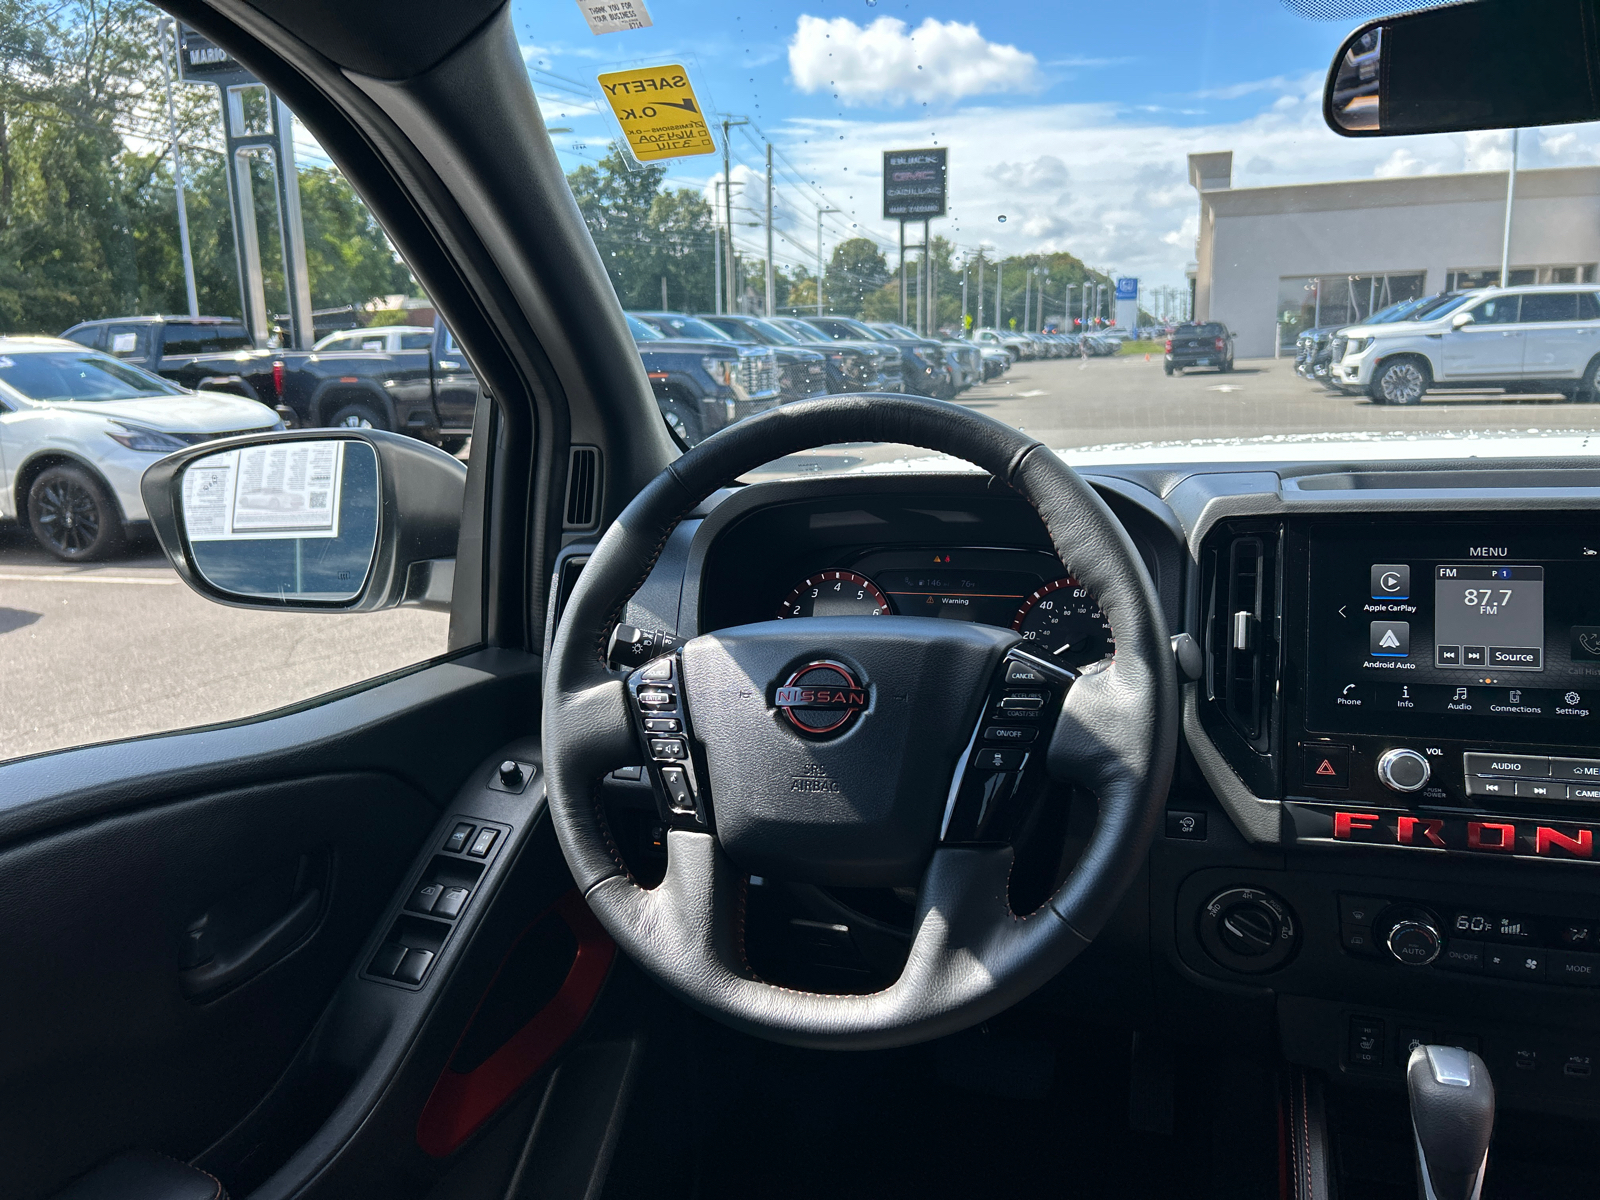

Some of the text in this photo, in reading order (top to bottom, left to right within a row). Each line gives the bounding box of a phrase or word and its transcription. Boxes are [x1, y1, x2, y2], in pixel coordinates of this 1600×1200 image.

[588, 1, 634, 15] THANK YOU FOR
[592, 10, 637, 22] YOUR BUSINESS
[1469, 547, 1508, 557] MENU
[1440, 568, 1457, 577] FM
[833, 582, 841, 592] 4
[811, 588, 819, 598] 3
[856, 590, 864, 600] 5
[1072, 588, 1087, 598] 60
[1464, 589, 1513, 606] 87.7
[941, 597, 969, 606] Warning
[1039, 600, 1053, 610] 40
[793, 605, 801, 615] 2
[1363, 604, 1417, 614] Apple CarPlay
[1480, 606, 1497, 615] FM
[1022, 630, 1036, 640] 20
[1495, 652, 1534, 662] Source
[1363, 661, 1416, 670] Android Auto
[778, 687, 865, 705] NISSAN
[1337, 697, 1362, 706] Phone
[1397, 700, 1414, 708] Info
[1447, 702, 1472, 711] Audio
[1490, 704, 1541, 714] Connections
[1555, 706, 1590, 717] Settings
[996, 730, 1022, 738] ON/OFF
[1491, 762, 1521, 771] AUDIO
[1584, 767, 1600, 775] ME
[791, 779, 840, 793] AIRBAG
[1575, 789, 1600, 798] CAME
[1209, 903, 1221, 918] 2WD
[1402, 947, 1426, 956] AUTO
[1449, 951, 1479, 961] ON-OFF
[1566, 964, 1592, 974] MODE
